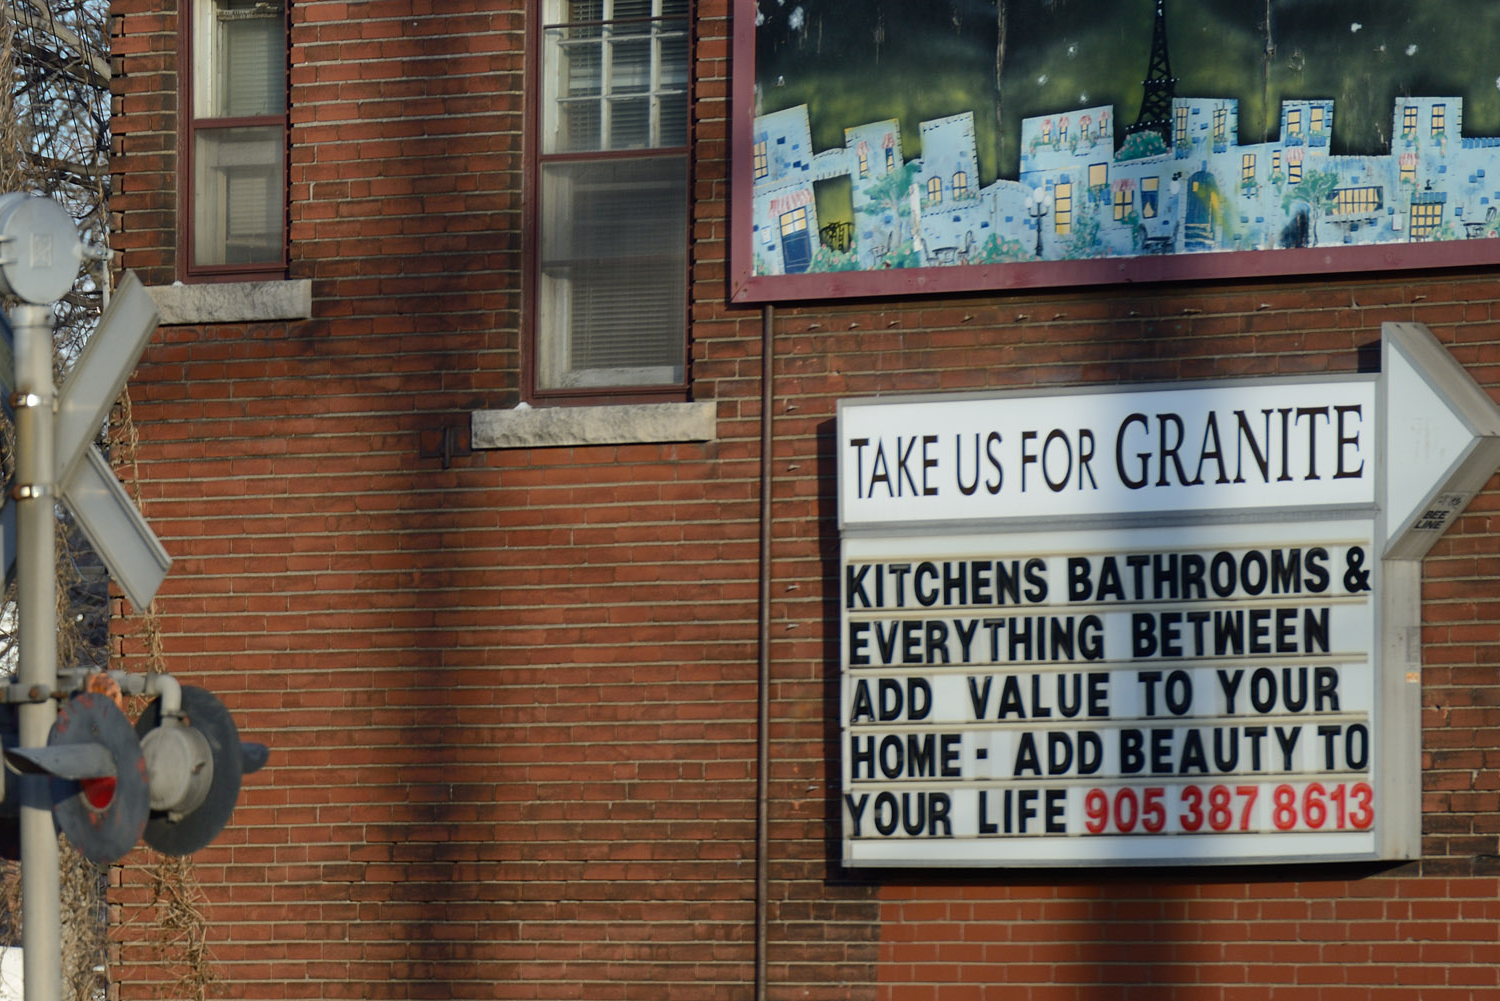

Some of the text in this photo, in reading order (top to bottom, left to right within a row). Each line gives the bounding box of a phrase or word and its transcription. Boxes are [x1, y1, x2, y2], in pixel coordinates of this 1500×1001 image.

[850, 404, 1365, 499] TAKE US FOR GRANITE
[1414, 520, 1444, 529] LINE
[1422, 510, 1451, 520] BEE
[846, 546, 1372, 608] KITCHENS BATHROOMS &
[849, 607, 1331, 665] EVERYTHING BETWEEN
[850, 666, 1341, 722] ADD VALUE TO YOUR
[851, 733, 963, 780] HOME
[1013, 731, 1104, 776] ADD
[1120, 726, 1303, 774] BEAUTY
[1317, 723, 1370, 771] TO
[844, 782, 1375, 837] YOUR LIFE 905 387 8613
